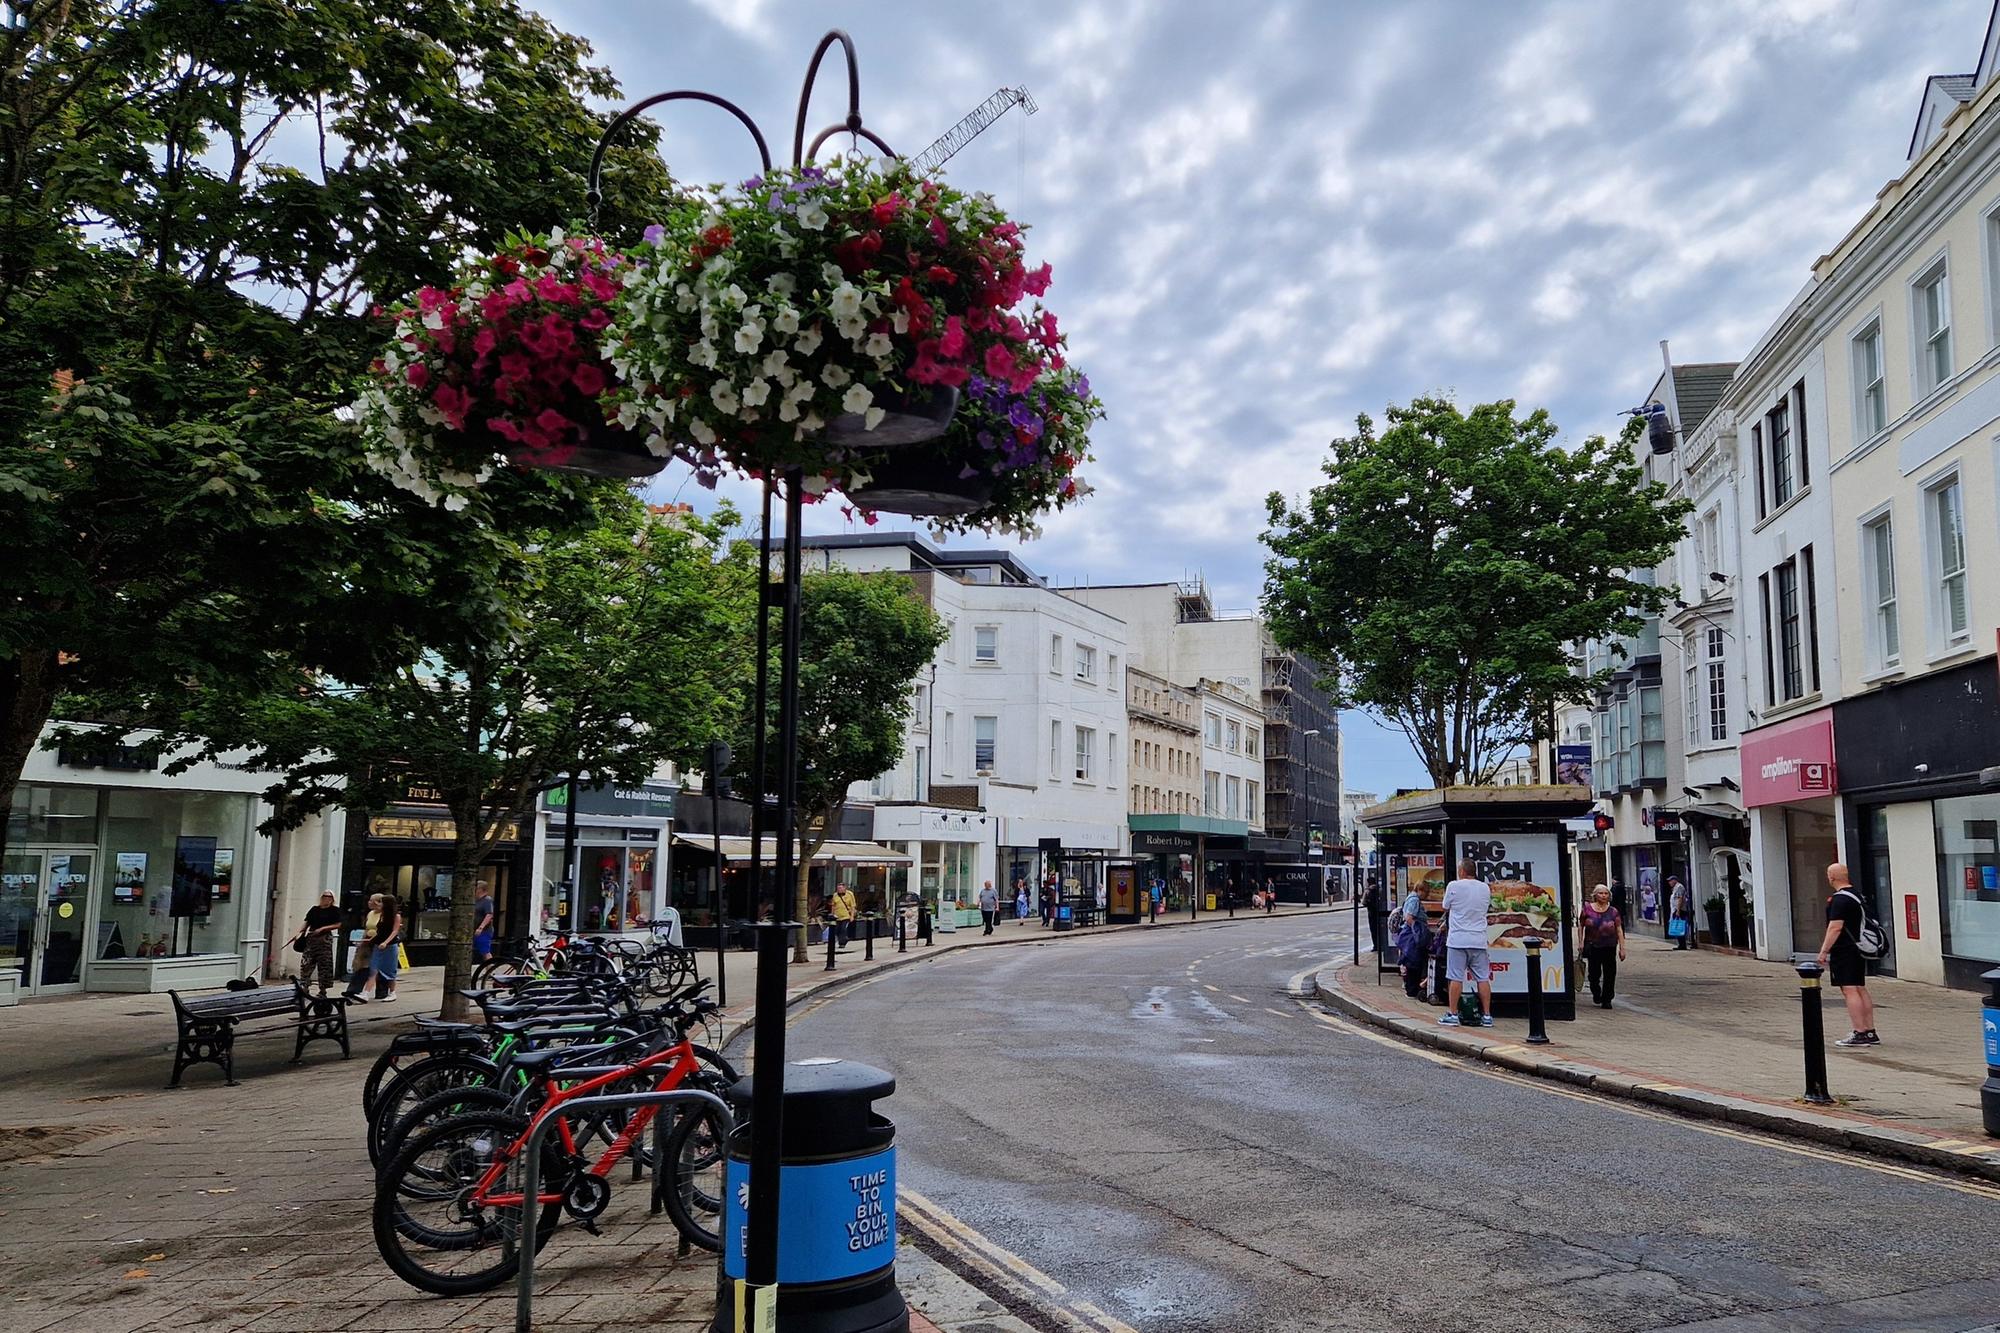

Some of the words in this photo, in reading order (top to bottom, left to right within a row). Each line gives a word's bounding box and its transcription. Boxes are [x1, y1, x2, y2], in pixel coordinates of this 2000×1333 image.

[1761, 756, 1793, 782] amplifon
[408, 787, 429, 799] FINE
[614, 790, 625, 799] Cat
[625, 791, 631, 799] &
[631, 791, 650, 801] Rabbit
[650, 792, 671, 802] Rescue
[1146, 835, 1172, 845] Robert
[1174, 837, 1192, 847] Dyas
[1462, 841, 1506, 862] BIG
[1477, 861, 1532, 883] RCH
[850, 1169, 886, 1190] TIME
[860, 1186, 880, 1203] TO
[857, 1200, 882, 1219] BIN
[847, 1213, 888, 1236] YOUR
[849, 1226, 889, 1251] GUM?
